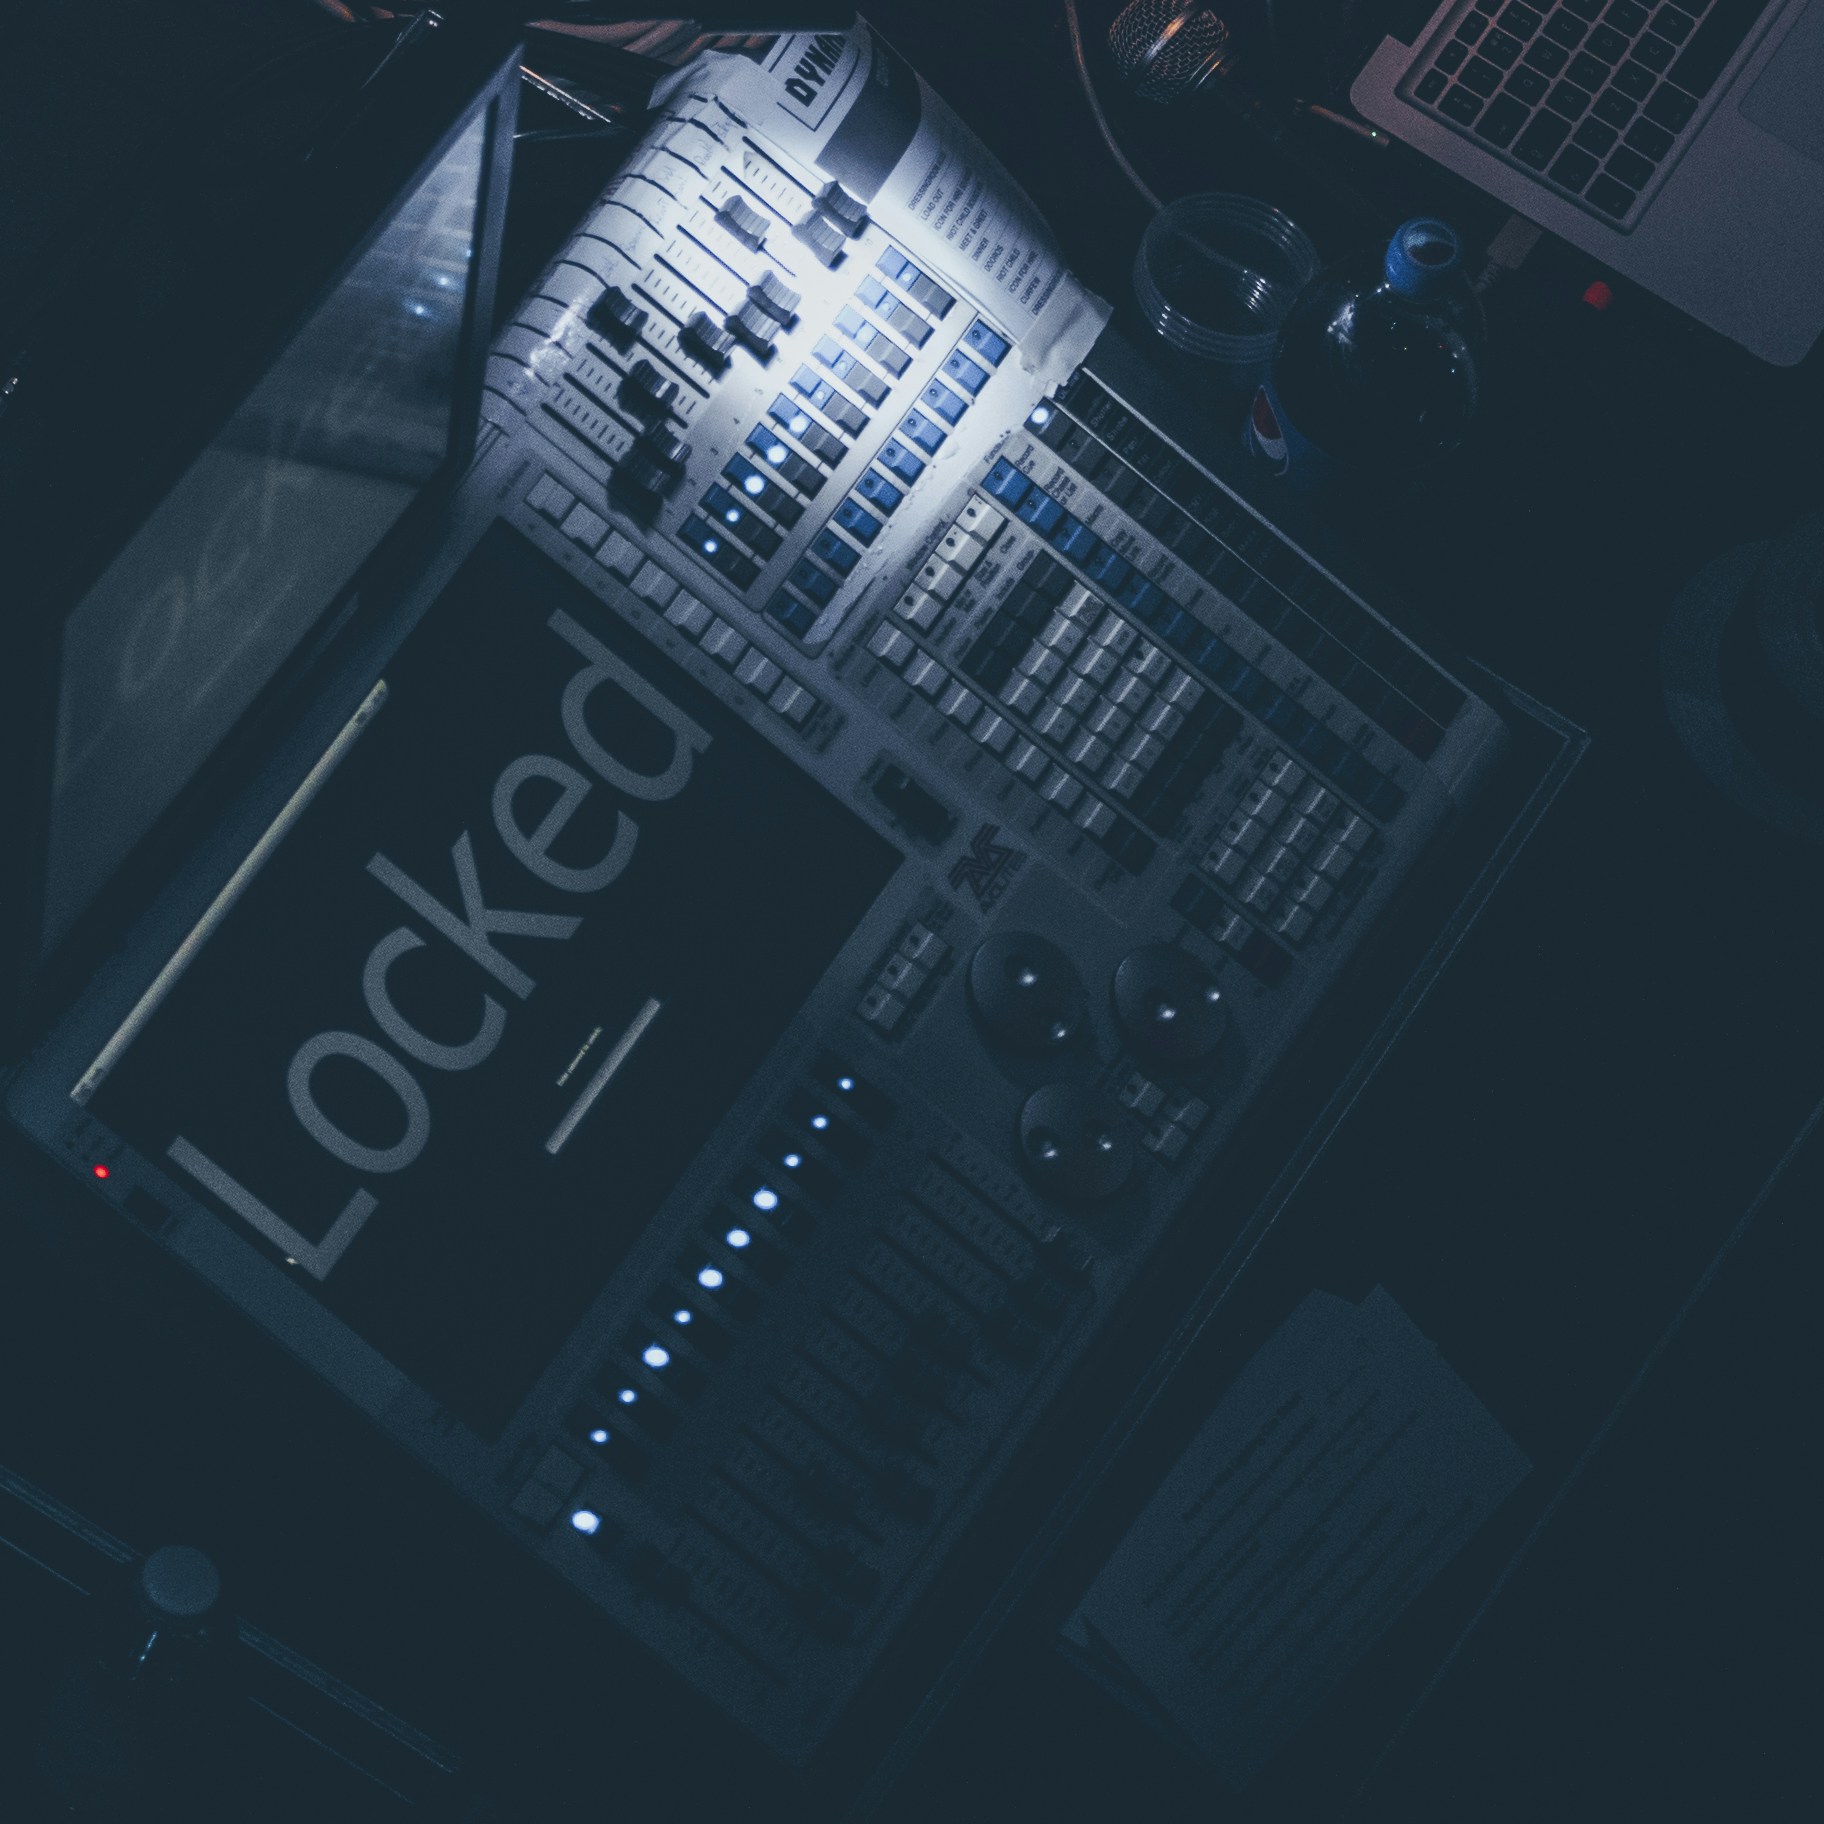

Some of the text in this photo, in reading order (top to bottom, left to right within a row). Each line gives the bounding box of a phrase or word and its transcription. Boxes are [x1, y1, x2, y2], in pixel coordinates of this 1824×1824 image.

[919, 187, 944, 221] LOAD OUT
[942, 200, 956, 215] FOR
[945, 224, 959, 241] RIOT
[954, 206, 971, 226] CHILD
[957, 231, 974, 252] MEET
[970, 236, 990, 262] DINNER
[995, 247, 1021, 283] RIOT CHILD
[1007, 275, 1022, 294] ICON
[1017, 262, 1030, 278] FOR
[1019, 275, 1041, 305] CURFEW
[164, 606, 718, 1284] Locked
